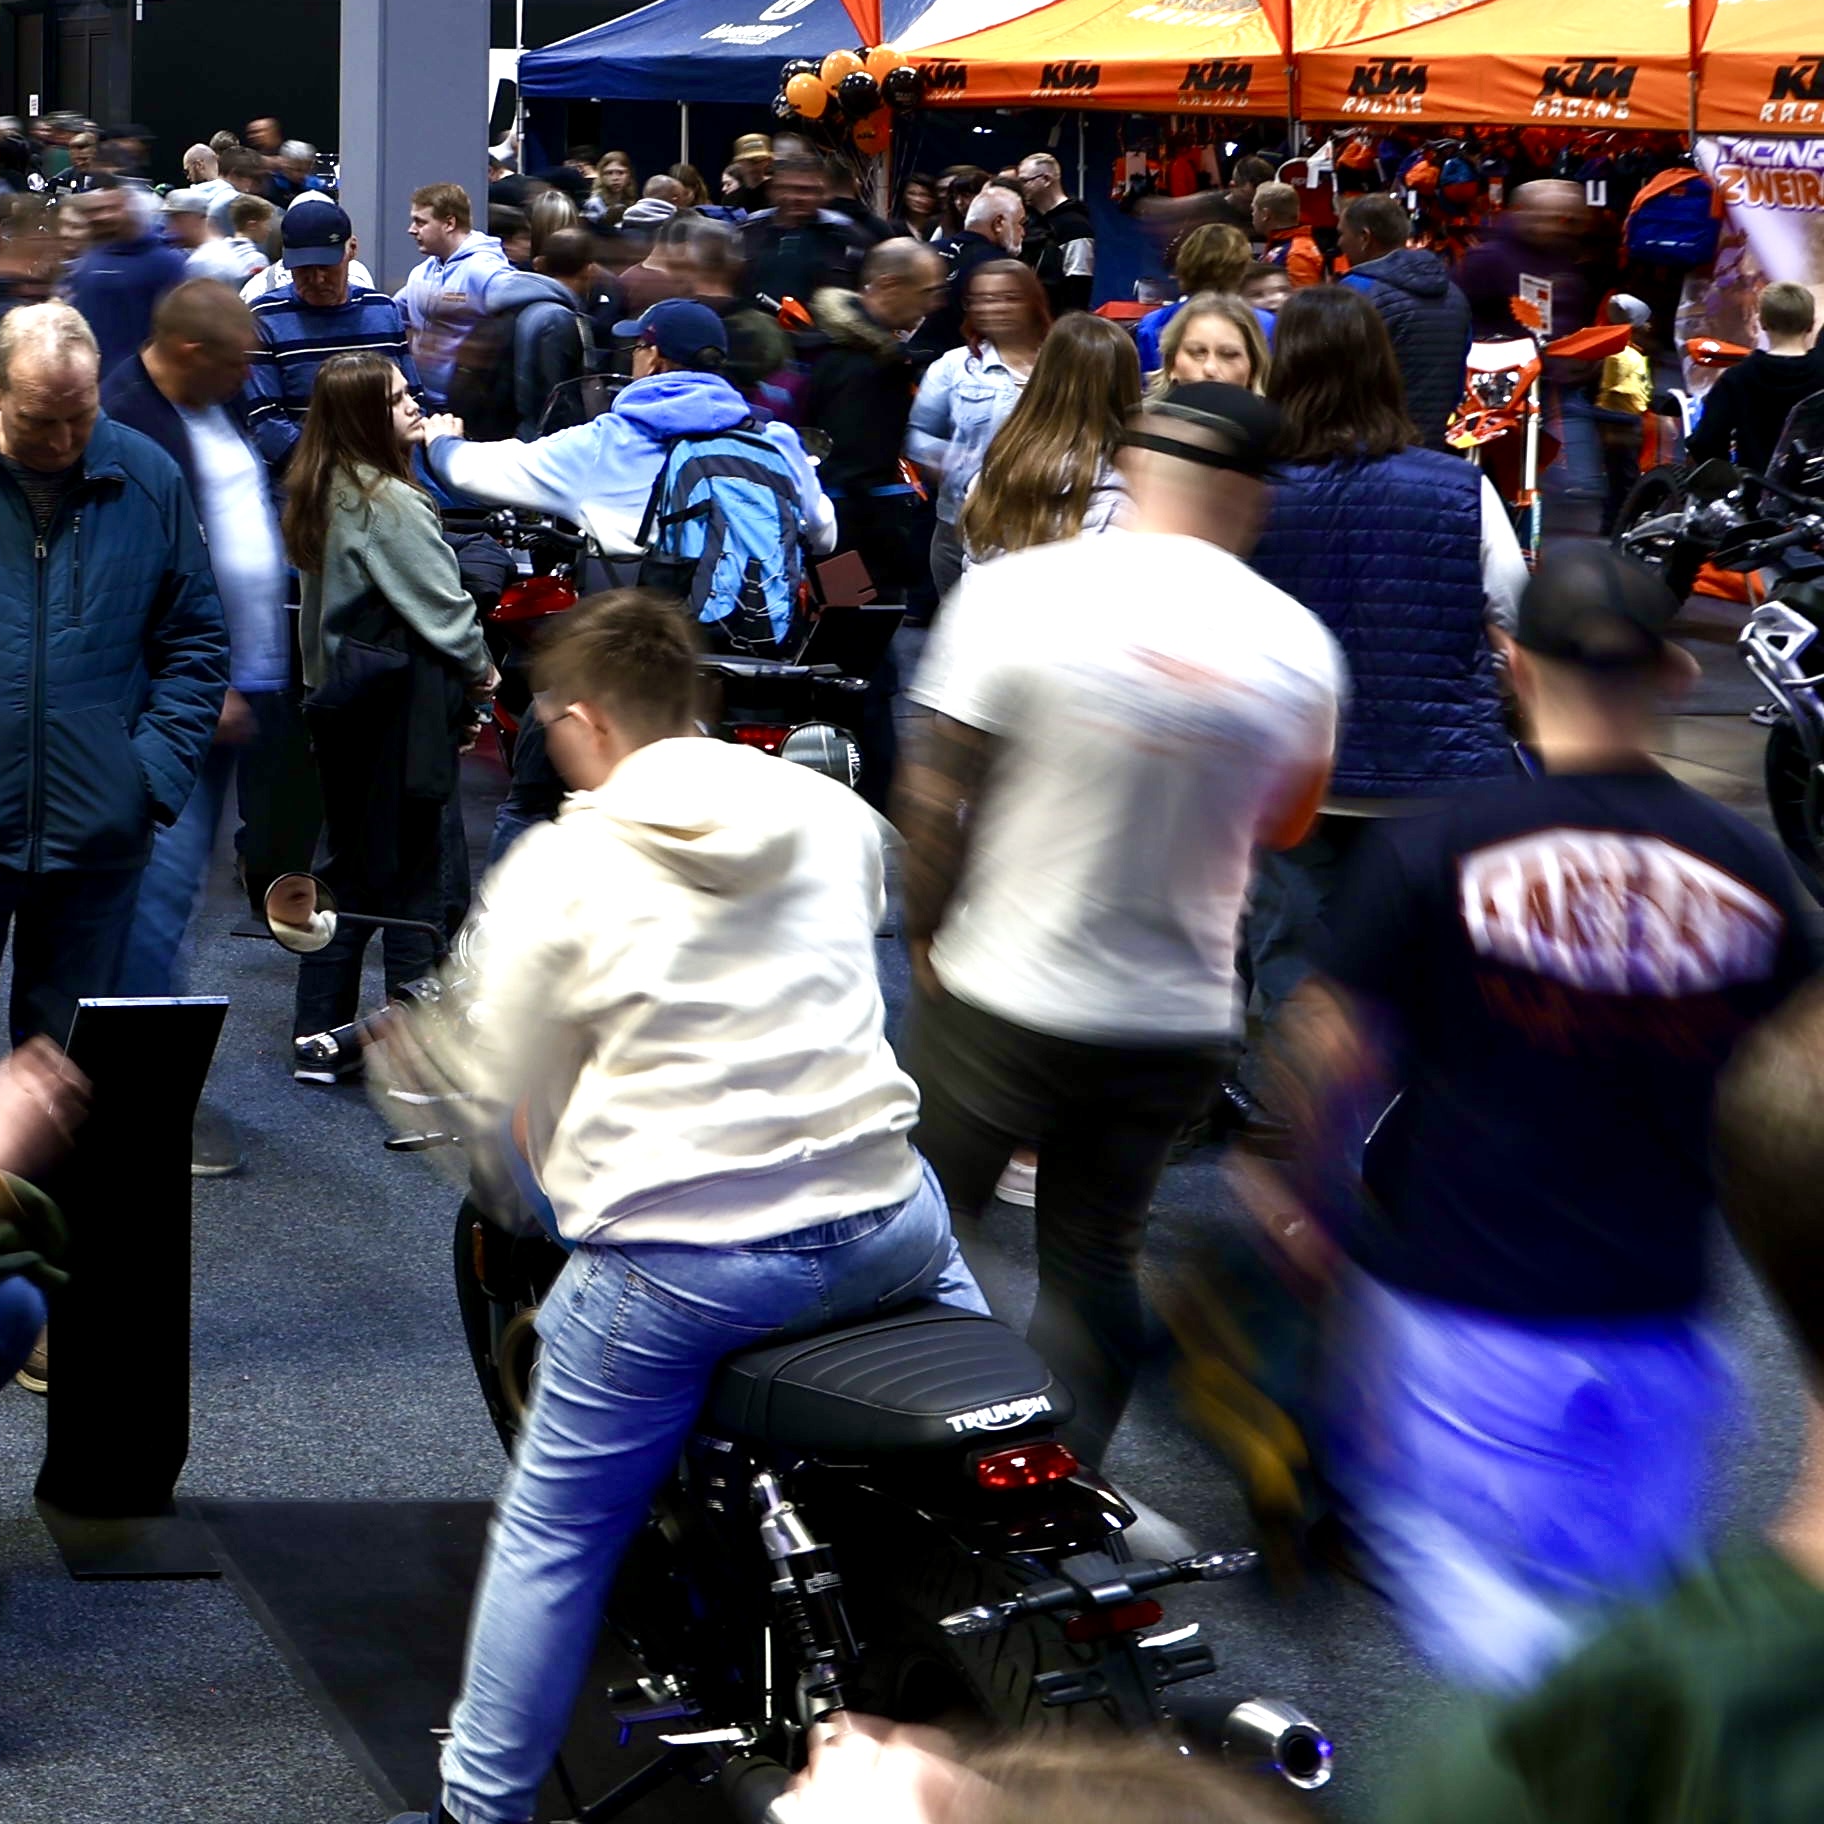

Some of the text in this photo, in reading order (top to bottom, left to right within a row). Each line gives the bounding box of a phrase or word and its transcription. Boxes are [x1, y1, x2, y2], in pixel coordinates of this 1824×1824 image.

[917, 58, 968, 91] KTM
[1039, 60, 1101, 91] KTM
[1178, 57, 1254, 93] KTM
[1347, 57, 1429, 96] KTM
[1538, 56, 1639, 99] KTM
[1530, 97, 1631, 120] RACING
[1716, 165, 1824, 206] ZWEIR
[946, 1394, 1052, 1434] TRIUMPH
